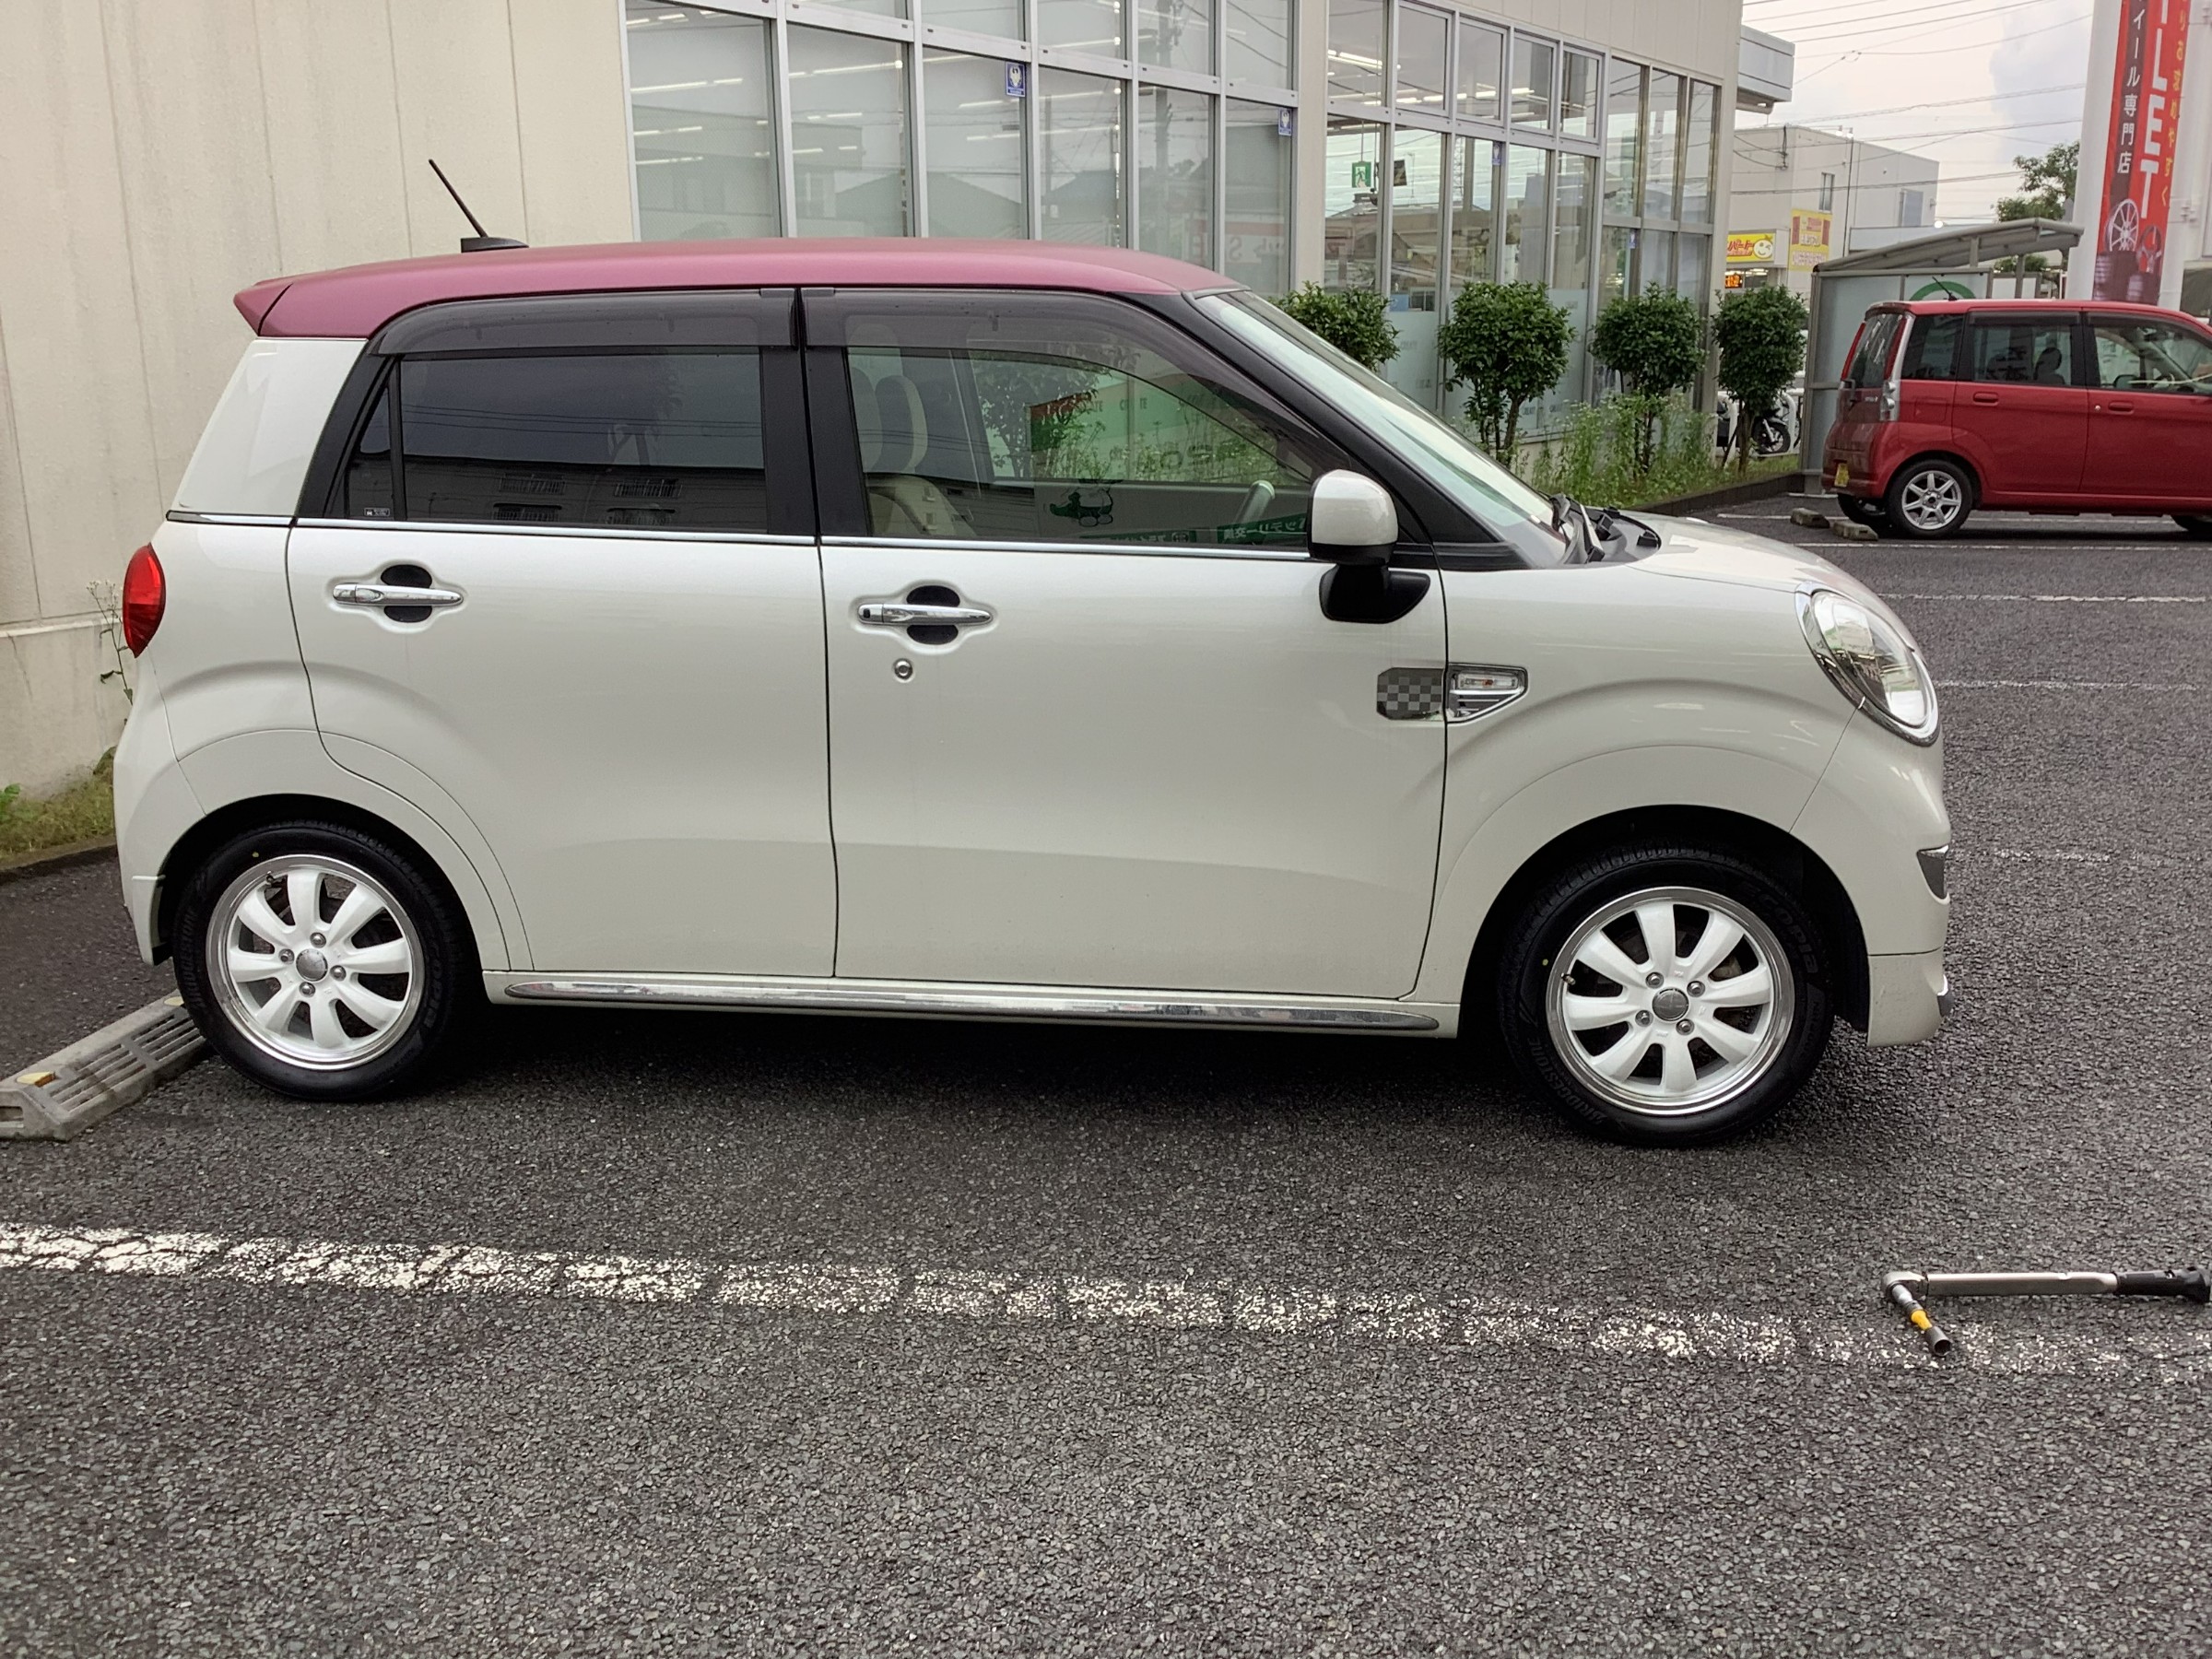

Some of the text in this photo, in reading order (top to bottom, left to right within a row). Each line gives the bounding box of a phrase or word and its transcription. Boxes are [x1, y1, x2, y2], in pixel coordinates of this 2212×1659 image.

[2117, 0, 2145, 174] イール専門店
[1527, 1038, 1607, 1126] BRIDGESTONE
